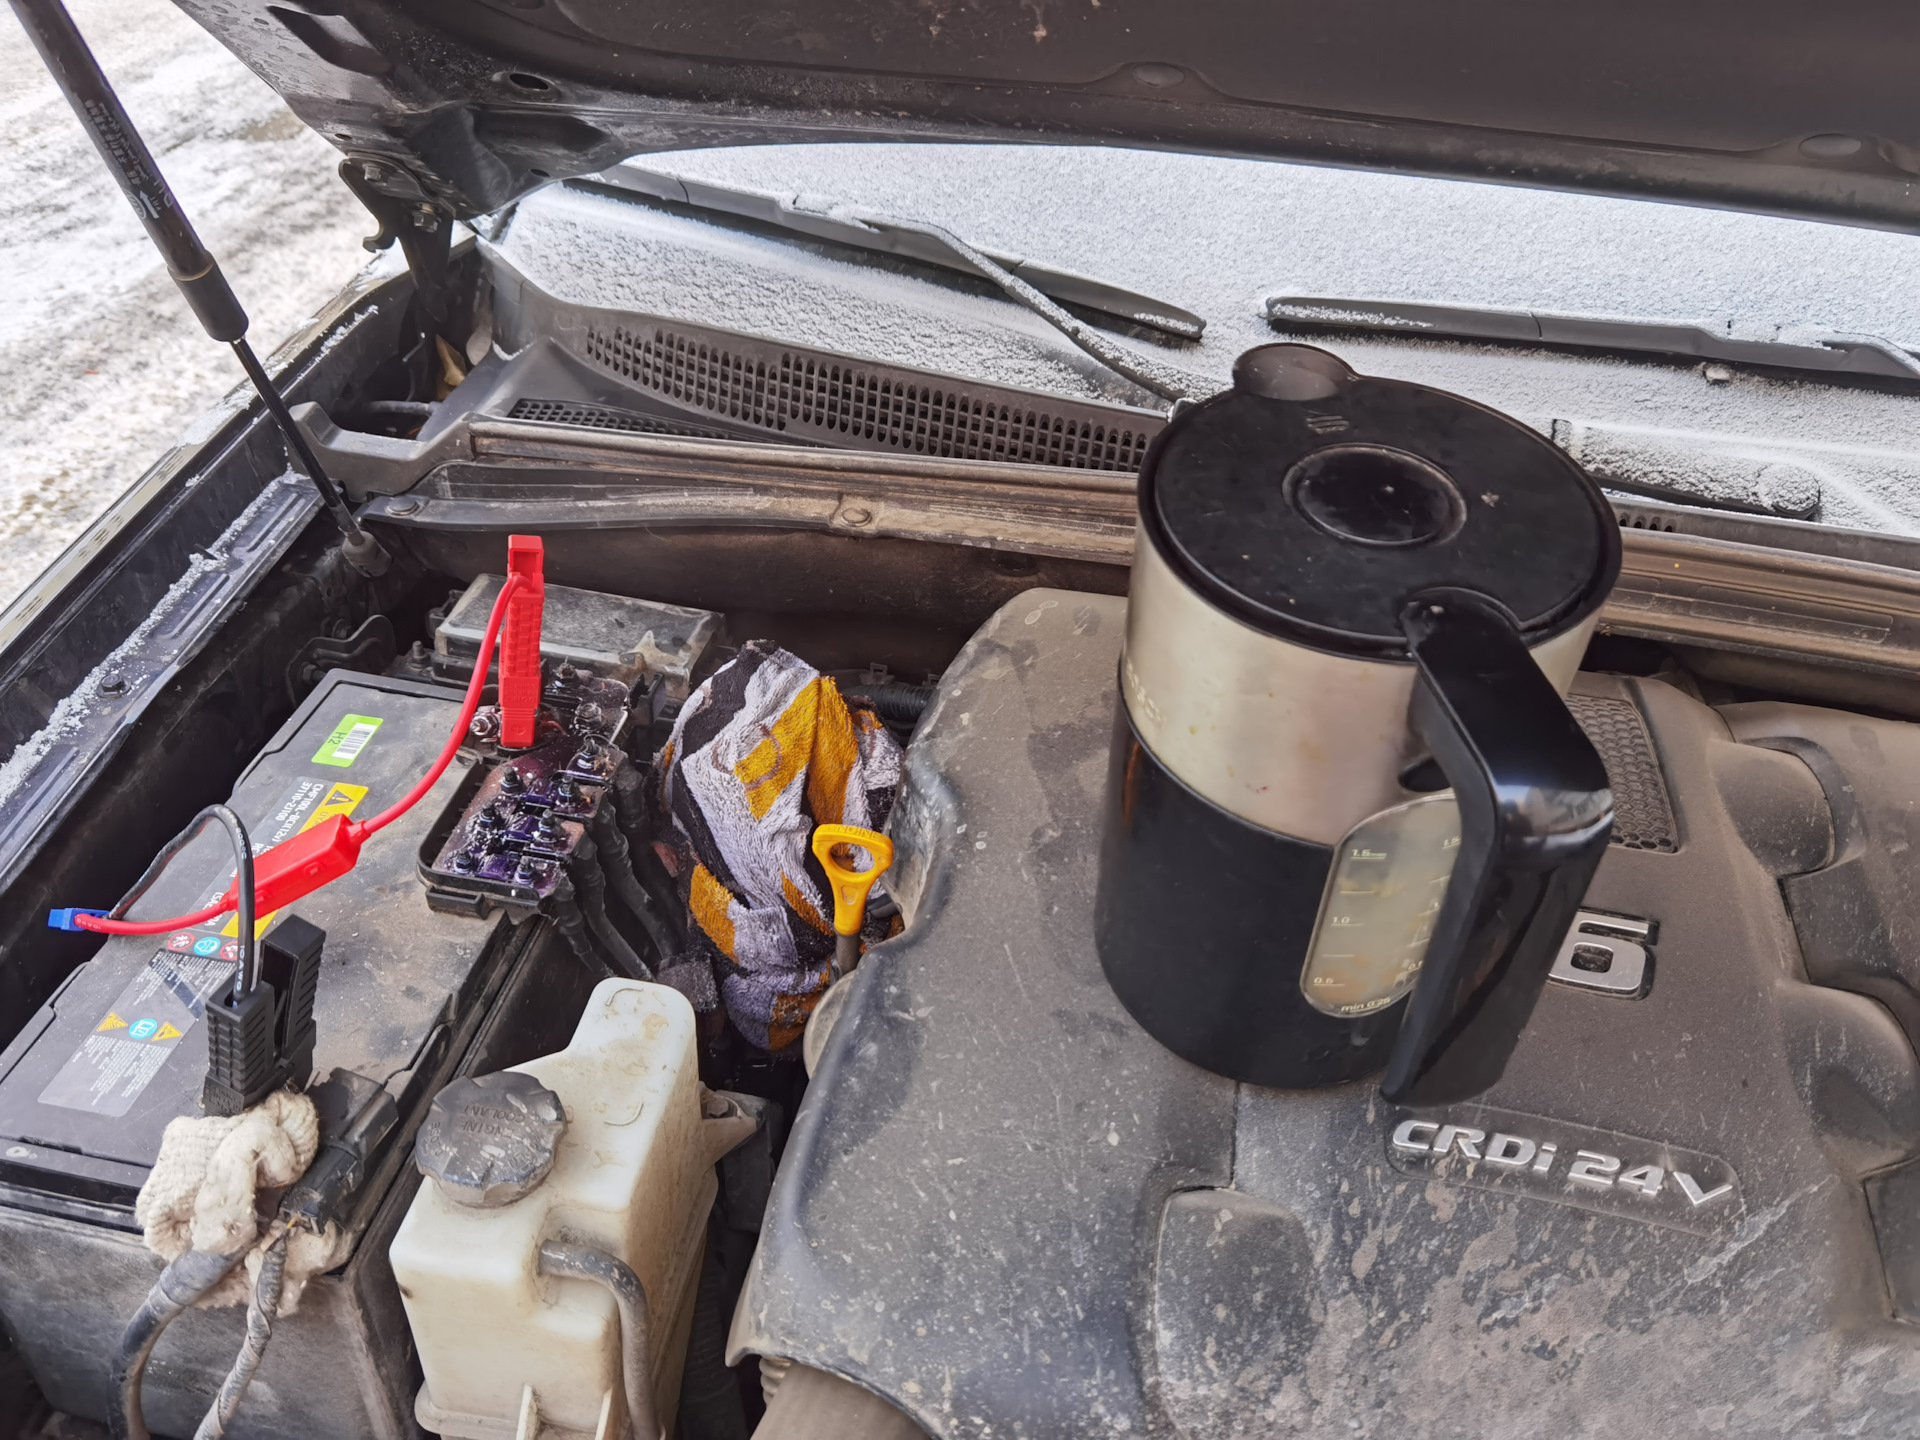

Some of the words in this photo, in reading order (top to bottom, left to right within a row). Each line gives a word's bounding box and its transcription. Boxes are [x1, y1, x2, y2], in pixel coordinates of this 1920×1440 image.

[327, 731, 347, 745] H2
[463, 1104, 525, 1123] COOLANT
[1392, 1118, 1557, 1172] CRDi
[1568, 1149, 1734, 1207] 24V
